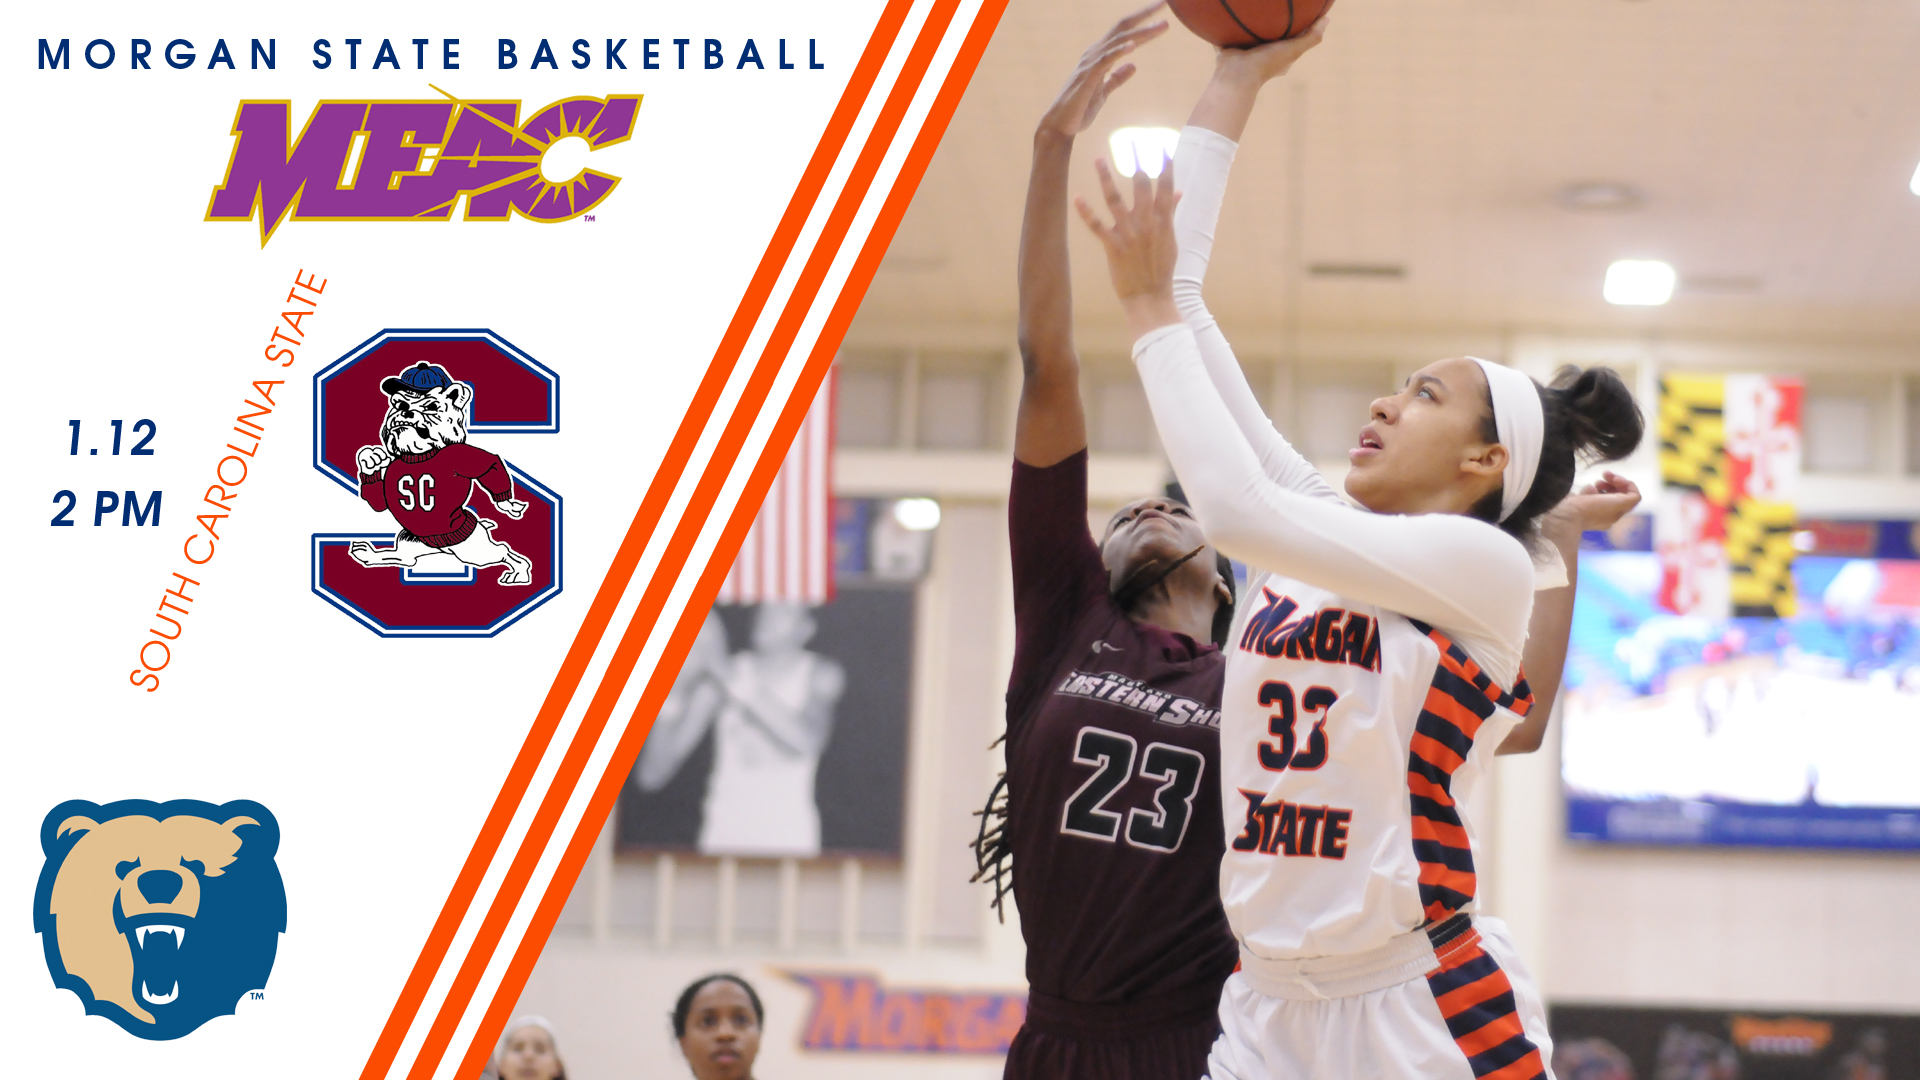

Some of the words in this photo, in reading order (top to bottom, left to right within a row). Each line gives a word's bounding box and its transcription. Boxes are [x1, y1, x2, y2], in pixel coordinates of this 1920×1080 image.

[1058, 671, 1166, 714] EASTERN
[1159, 698, 1221, 729] SHO
[1107, 673, 1172, 700] MARYLAND
[1257, 680, 1339, 772] 33
[1060, 726, 1205, 854] 23
[1232, 787, 1353, 861] STATE
[765, 965, 1030, 1053] MORGA
